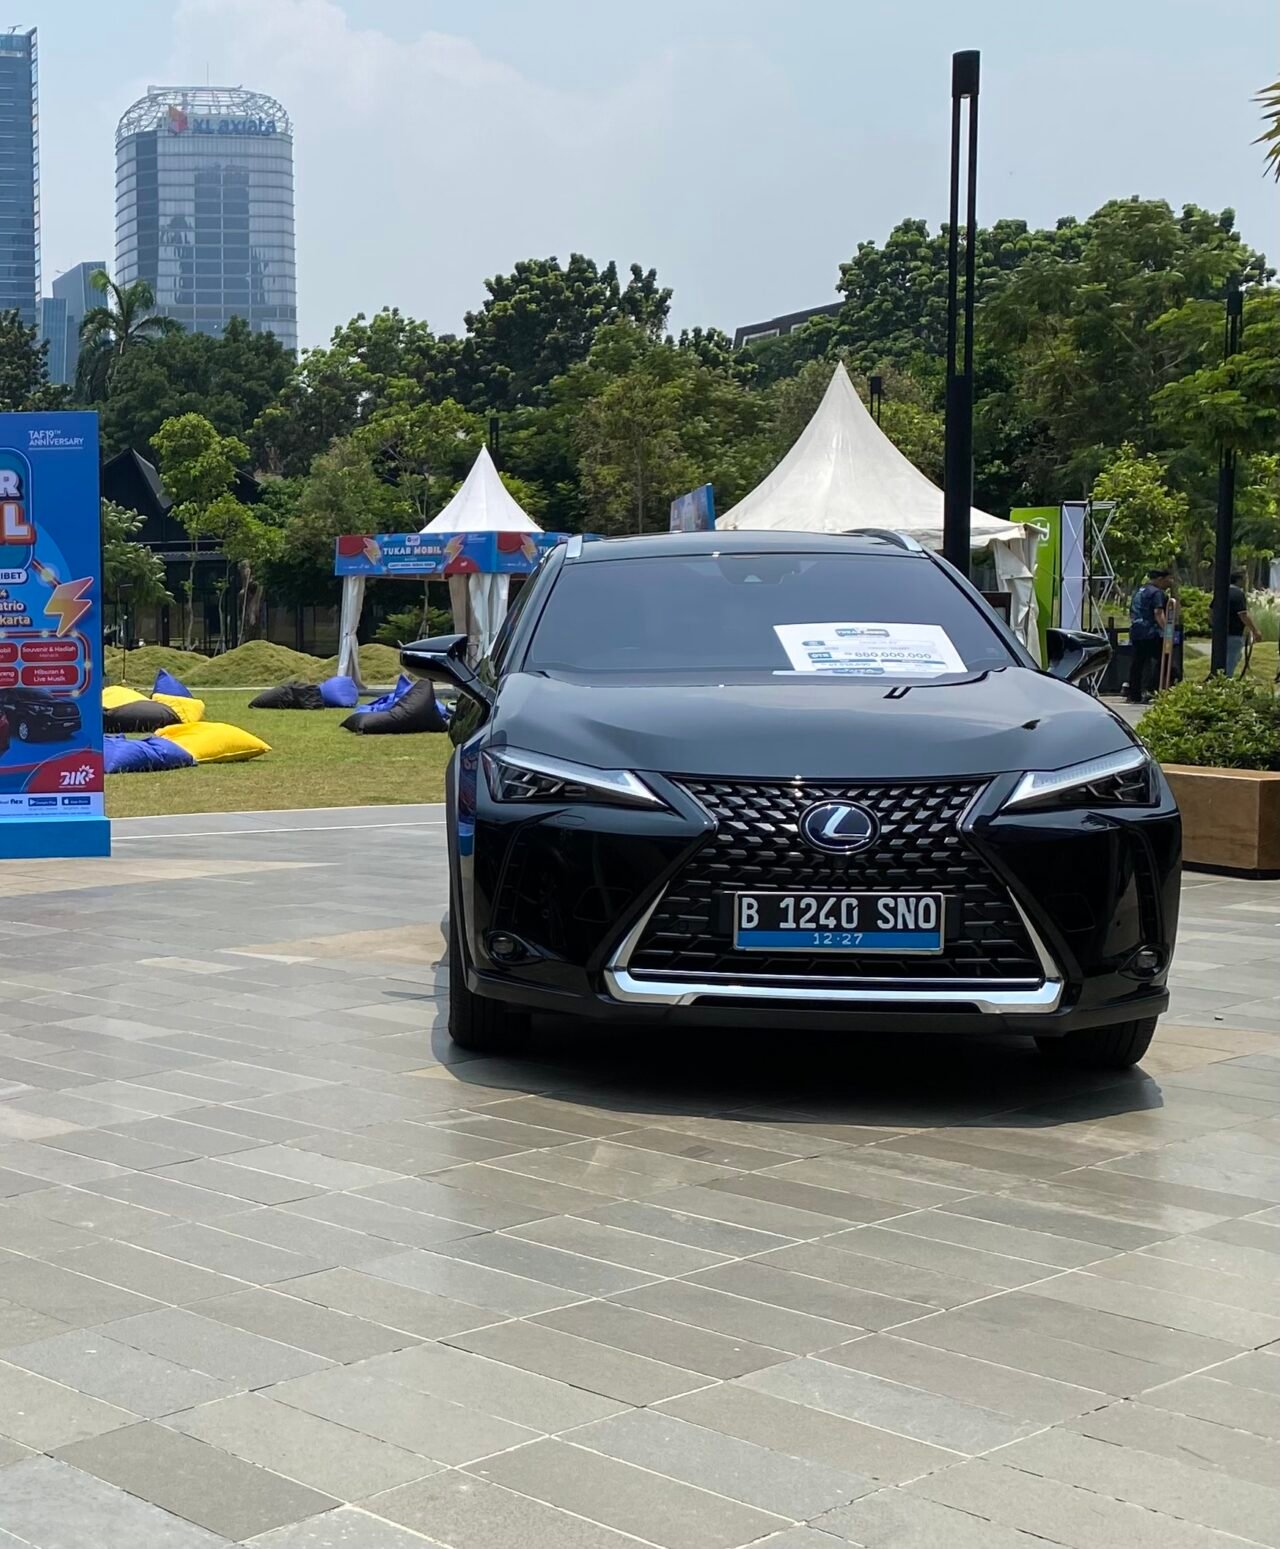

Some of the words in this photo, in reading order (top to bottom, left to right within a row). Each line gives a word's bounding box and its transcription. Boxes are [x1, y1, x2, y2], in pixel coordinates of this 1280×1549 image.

[192, 118, 215, 134] XL
[218, 116, 277, 136] axiata
[29, 438, 85, 446] ANNIVERSARY
[383, 547, 412, 555] TUKAR
[414, 546, 442, 554] MOBIL
[741, 897, 759, 929] B
[779, 897, 859, 929] 1240
[876, 897, 937, 929] SNO
